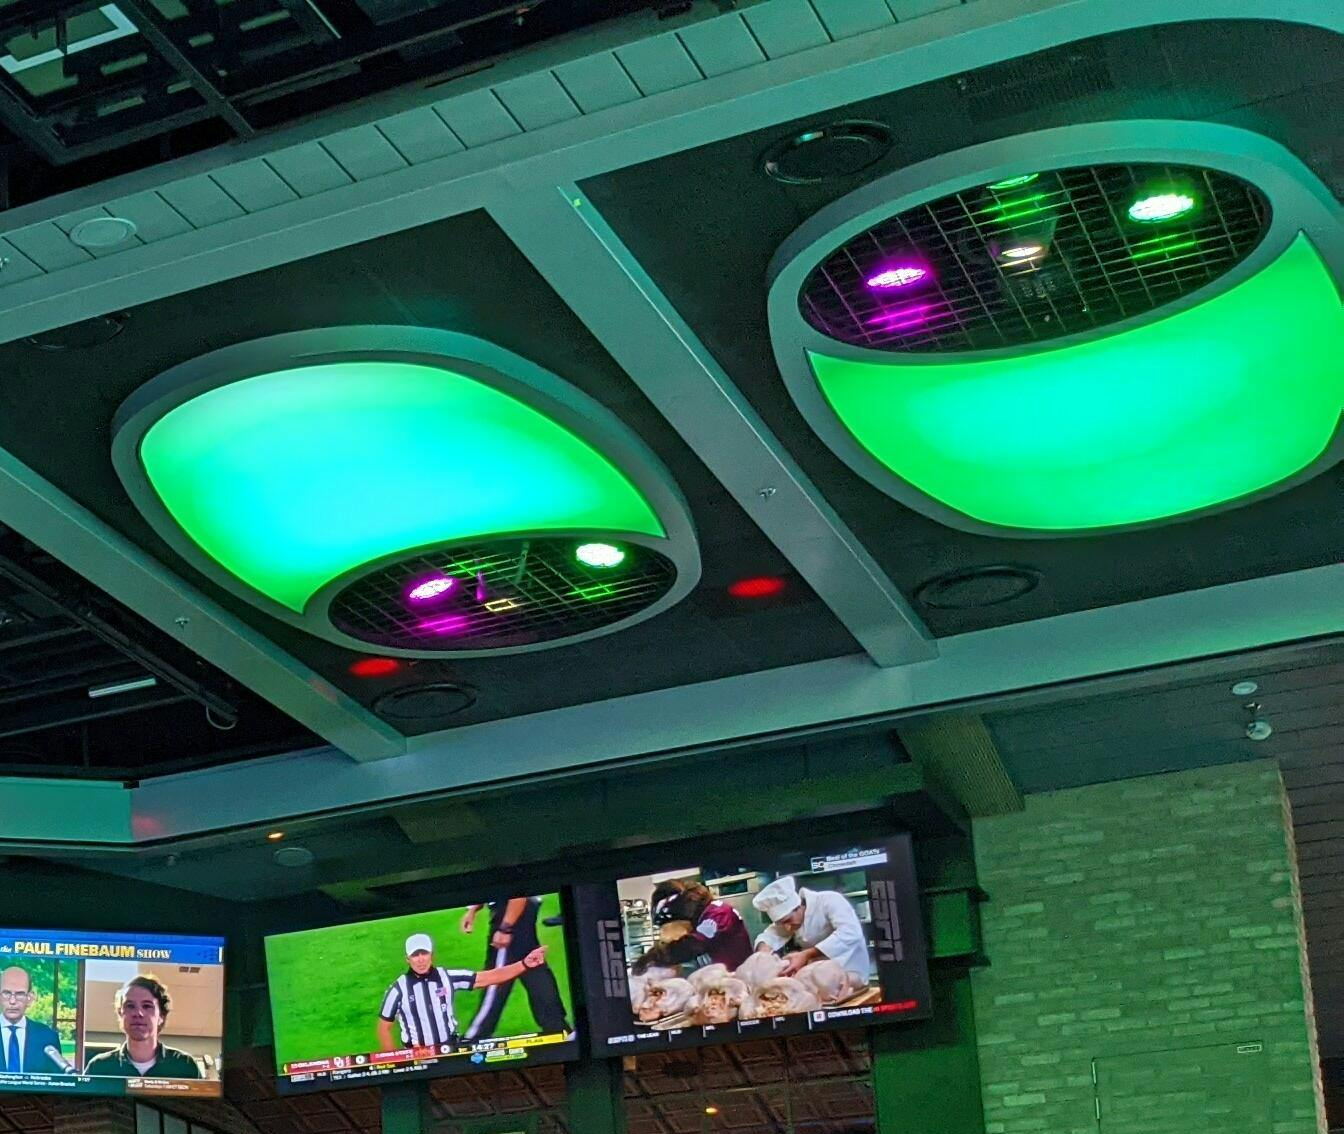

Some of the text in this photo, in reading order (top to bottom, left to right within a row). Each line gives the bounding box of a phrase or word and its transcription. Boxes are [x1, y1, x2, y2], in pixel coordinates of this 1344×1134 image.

[14, 941, 54, 955] PAUL
[55, 943, 135, 958] FINEBAUM
[137, 948, 172, 960] SHOW
[597, 920, 627, 998] ESPN
[871, 880, 903, 962] ESPN
